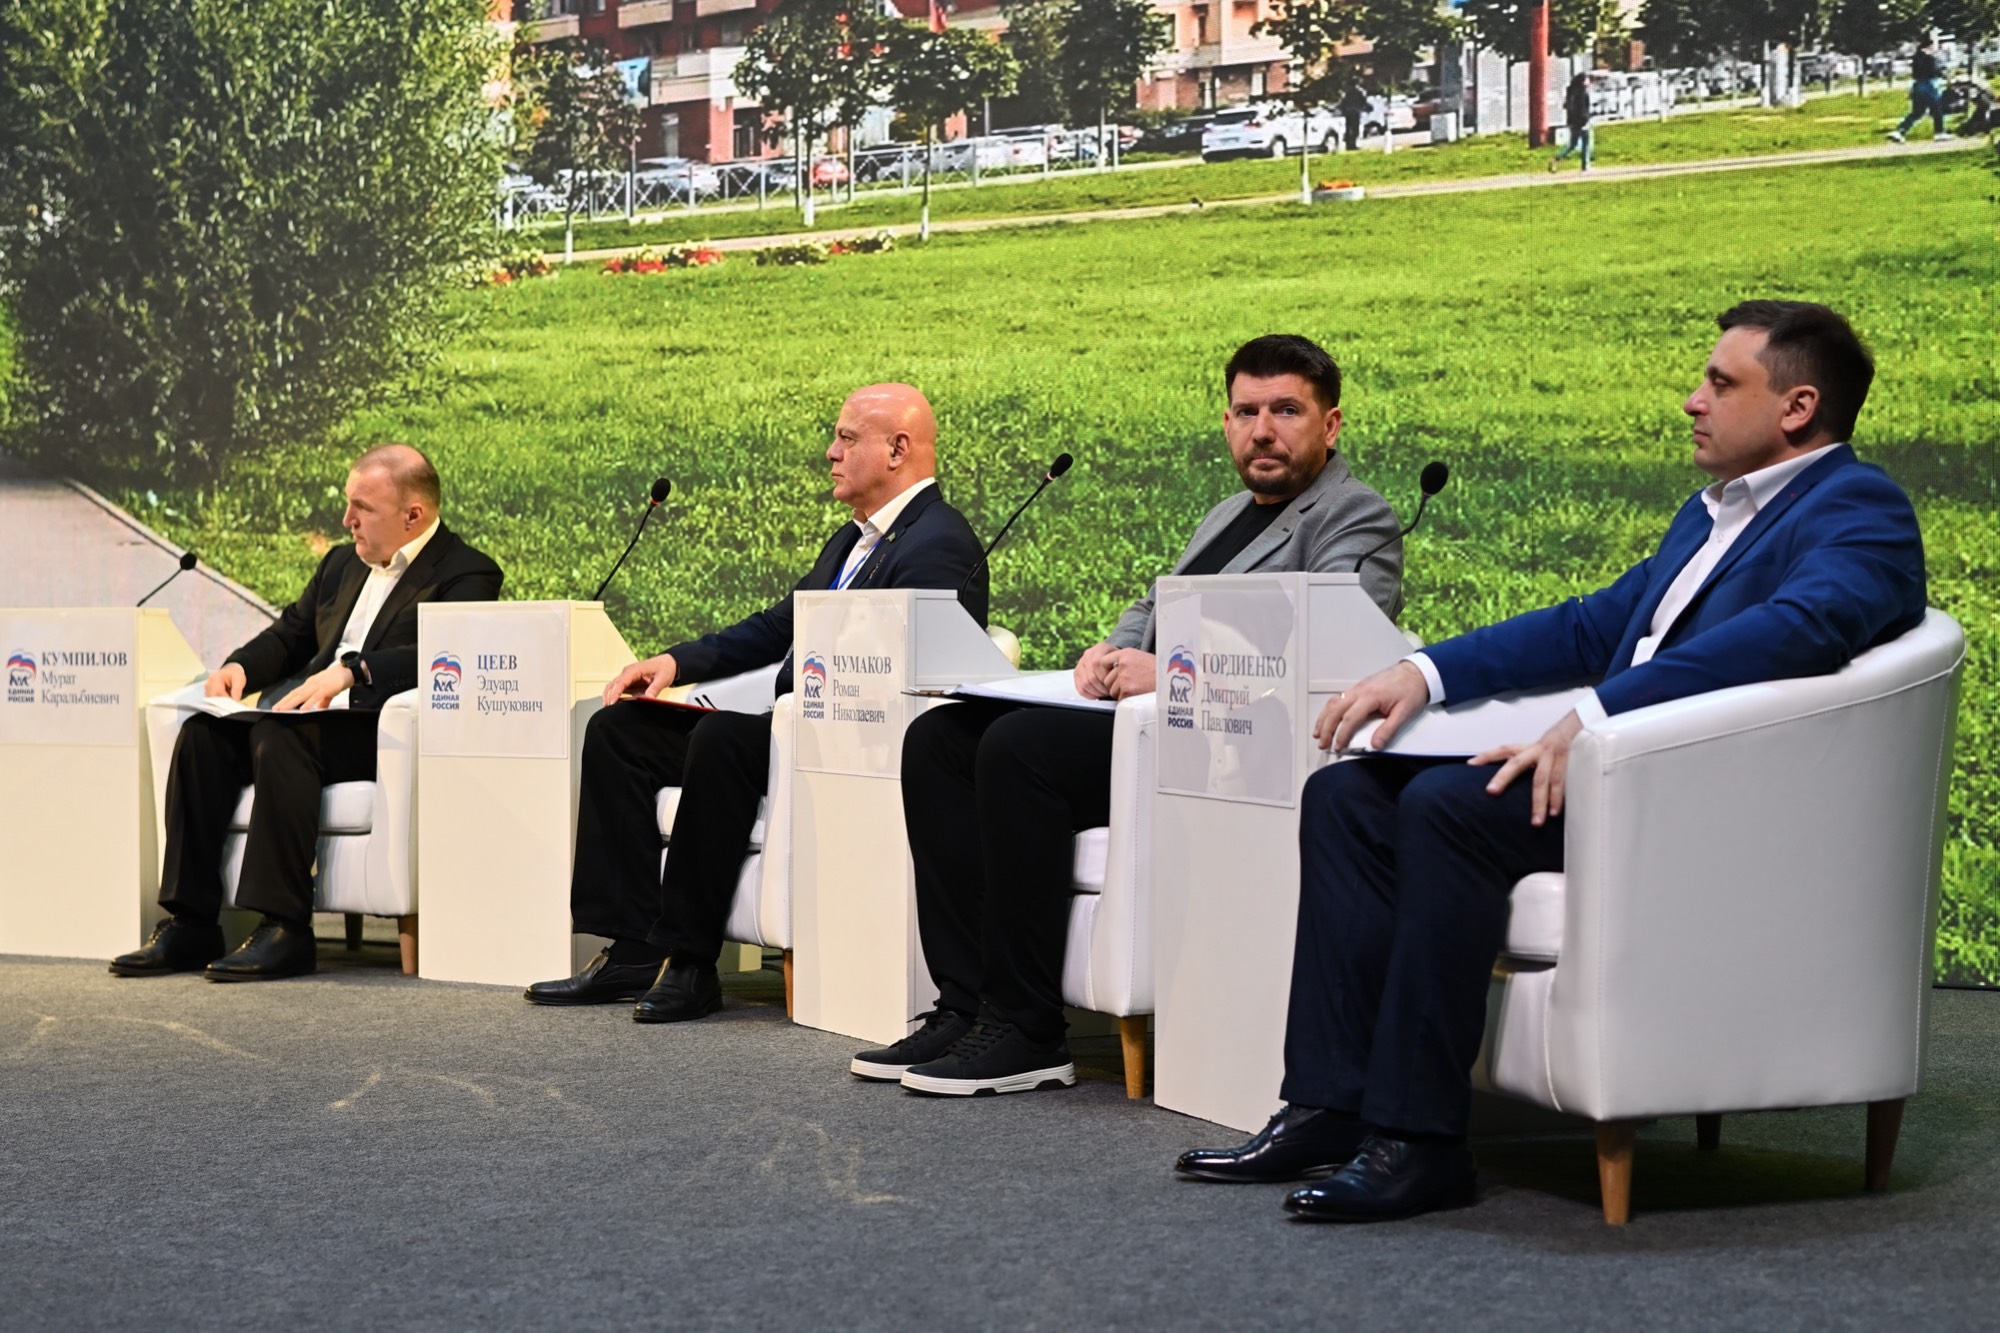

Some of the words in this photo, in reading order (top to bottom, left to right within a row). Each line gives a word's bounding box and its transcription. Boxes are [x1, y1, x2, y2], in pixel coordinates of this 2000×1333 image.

[42, 652, 128, 666] КУМПИЛОВ
[477, 655, 518, 672] ЦЕЕВ
[833, 655, 892, 674] ЧУМАКОВ
[1202, 653, 1287, 679] ГОРДИЕНКО
[41, 670, 77, 688] Мурат
[476, 675, 519, 695] Эдуард
[833, 679, 860, 697] Роман
[41, 689, 120, 707] Каральбиевич
[803, 700, 824, 709] ЕДИНАЯ
[1201, 682, 1250, 710] Дмитрий
[431, 702, 460, 710] РОССИЯ
[477, 696, 543, 715] Кушукович
[803, 710, 824, 719] РОССИЯ
[832, 703, 885, 723] Николаевич
[1167, 705, 1194, 716] ЕДИНАЯ
[1167, 717, 1194, 729] РОССИЯ
[1201, 710, 1253, 735] Павлович
